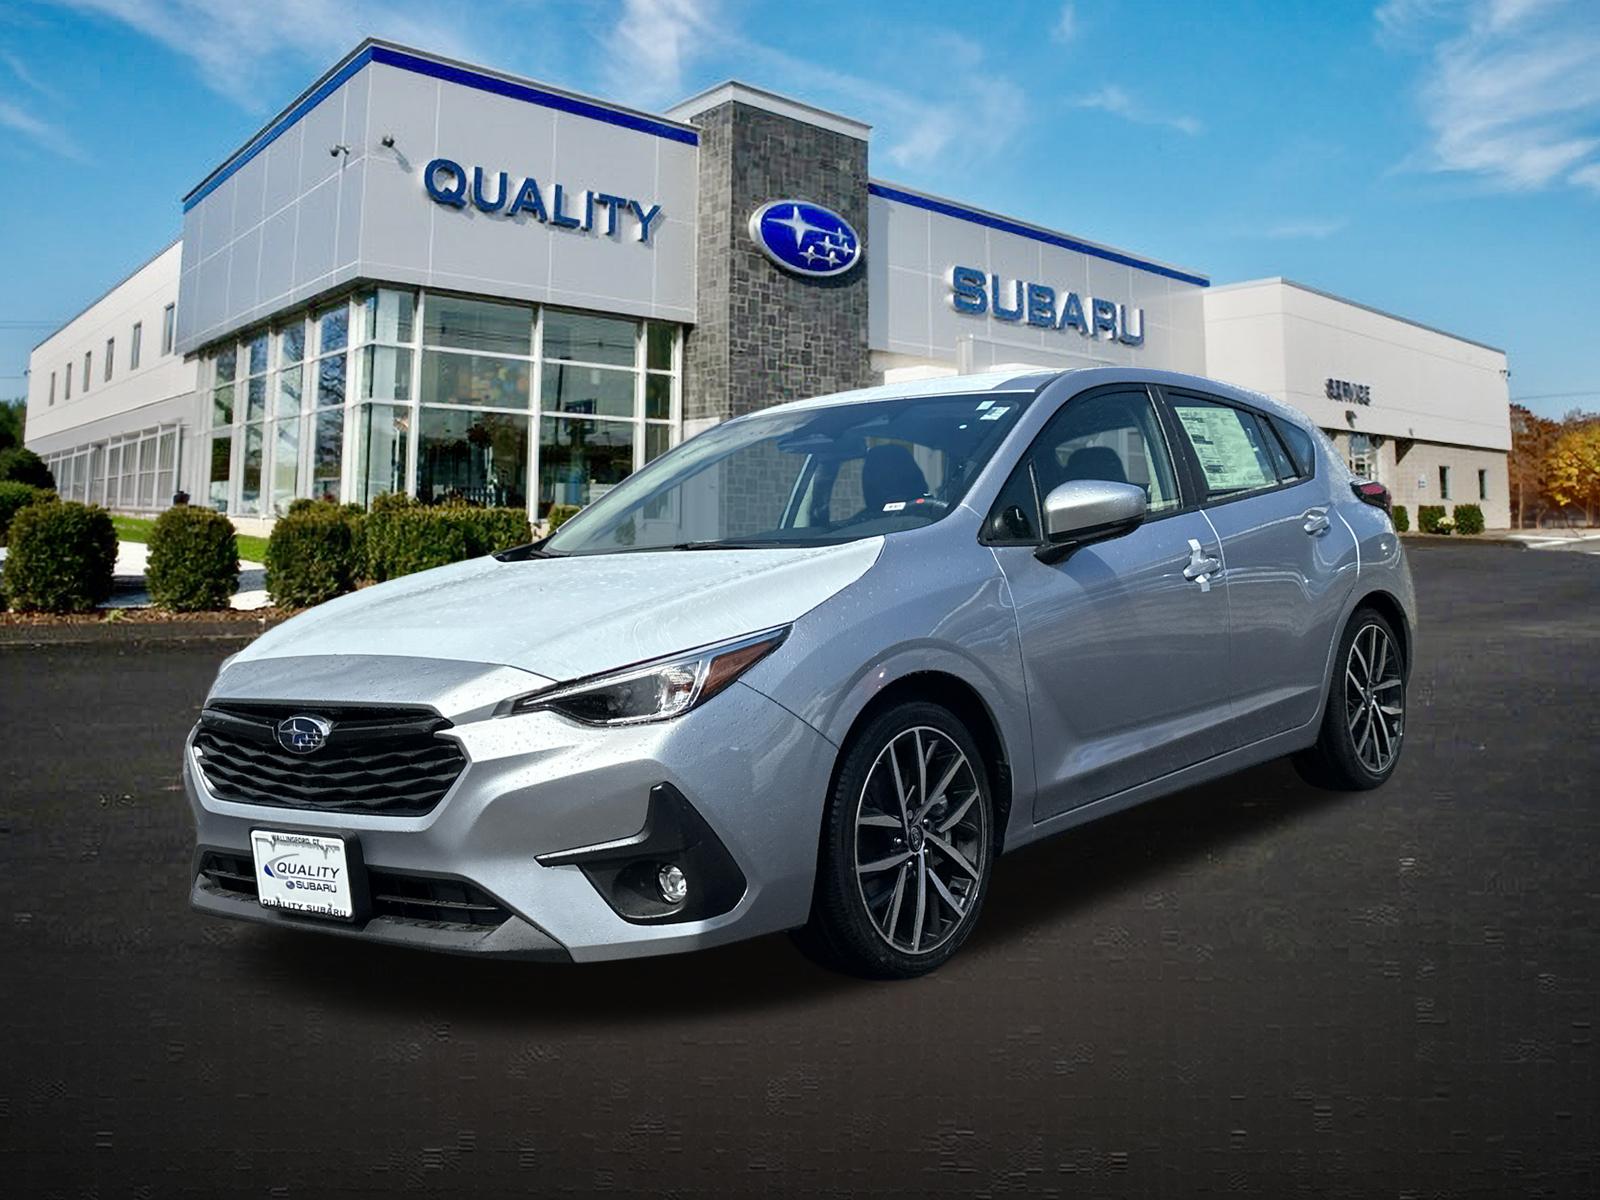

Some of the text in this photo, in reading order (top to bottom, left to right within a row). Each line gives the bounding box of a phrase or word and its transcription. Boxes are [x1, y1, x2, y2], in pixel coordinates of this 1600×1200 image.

[424, 158, 662, 243] QUALITY
[950, 265, 1145, 347] SUBARU
[1325, 377, 1371, 406] SERVICE
[277, 862, 340, 879] QUALITY
[295, 880, 337, 893] SUBARU
[262, 898, 347, 917] QUALITY SUBARU
